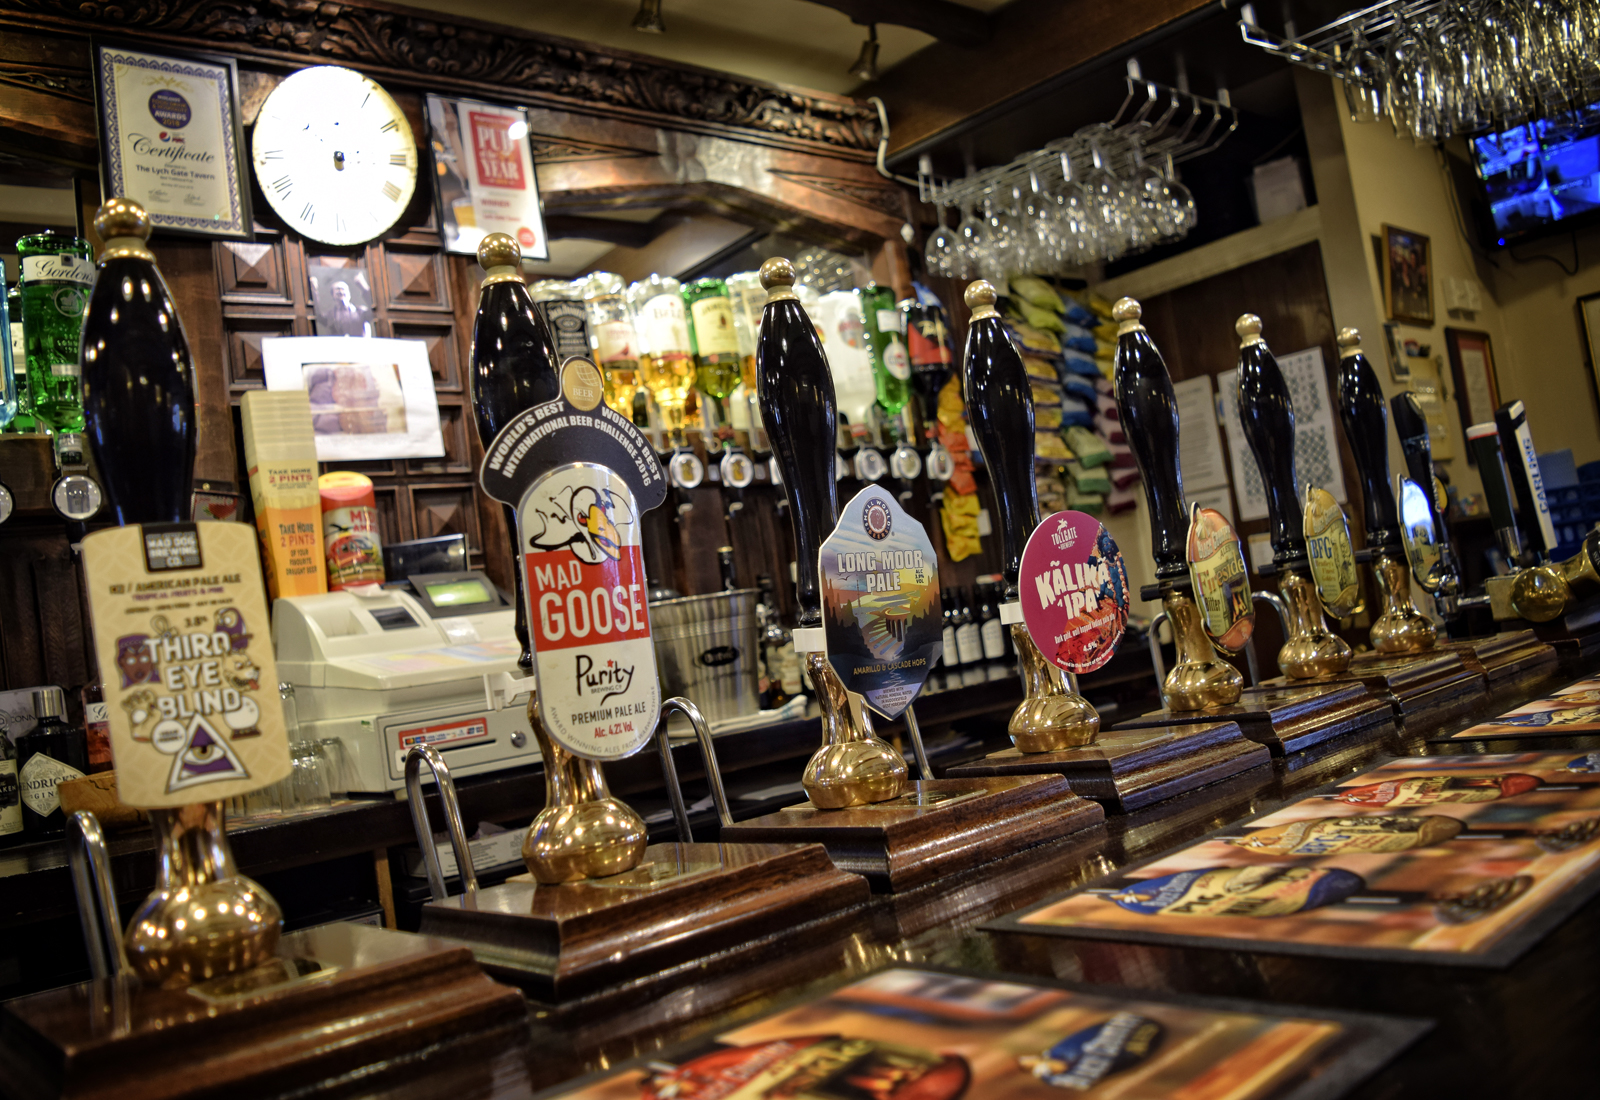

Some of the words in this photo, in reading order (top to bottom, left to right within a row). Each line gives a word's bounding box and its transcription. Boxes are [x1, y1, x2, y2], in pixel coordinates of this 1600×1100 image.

[154, 110, 187, 121] AWARDS
[127, 133, 215, 163] Certificate
[136, 165, 150, 173] The
[152, 166, 170, 176] Lych
[171, 168, 188, 178] Gate
[190, 171, 215, 180] Tavern
[481, 159, 520, 180] YEAR
[35, 258, 94, 284] Gordon's
[573, 387, 594, 397] BEER
[488, 414, 536, 471] WORLD'S
[534, 401, 564, 421] BEST
[602, 406, 644, 448] WORLD'S
[641, 446, 662, 481] BEST
[502, 416, 569, 479] INTERNATIONAL
[569, 415, 593, 427] BEER
[594, 418, 638, 459] CHALLENGE
[635, 456, 652, 487] 2016
[279, 475, 313, 483] PINTS
[279, 523, 296, 535] TAKE
[296, 522, 314, 533] HOME
[1051, 527, 1078, 546] TOLLGATE
[148, 538, 172, 549] MAD
[174, 536, 196, 548] DOG
[280, 536, 287, 548] 2
[289, 534, 316, 546] PINTS
[1310, 536, 1333, 560] BFG
[837, 552, 877, 573] LONG
[881, 549, 924, 570] MOOR
[136, 580, 191, 592] AMERICAN
[193, 576, 219, 586] PALE
[222, 574, 241, 583] ALE
[534, 560, 582, 591] MAD
[866, 571, 901, 593] PALE
[539, 584, 645, 641] GOOSE
[144, 632, 231, 663] THIRD
[166, 661, 221, 691] EYE
[853, 664, 880, 676] AMARILLO
[887, 660, 911, 671] CASCADE
[912, 658, 926, 666] HOPS
[575, 654, 634, 706] Purity
[591, 685, 614, 694] BREWING
[158, 688, 241, 719] BLIND
[571, 708, 612, 726] PREMIUM
[615, 704, 633, 718] PALE
[635, 701, 646, 714] ALE
[550, 706, 567, 735] AWARD
[567, 733, 602, 753] WINNING
[622, 739, 638, 750] FROM
[34, 791, 54, 800] GIN
